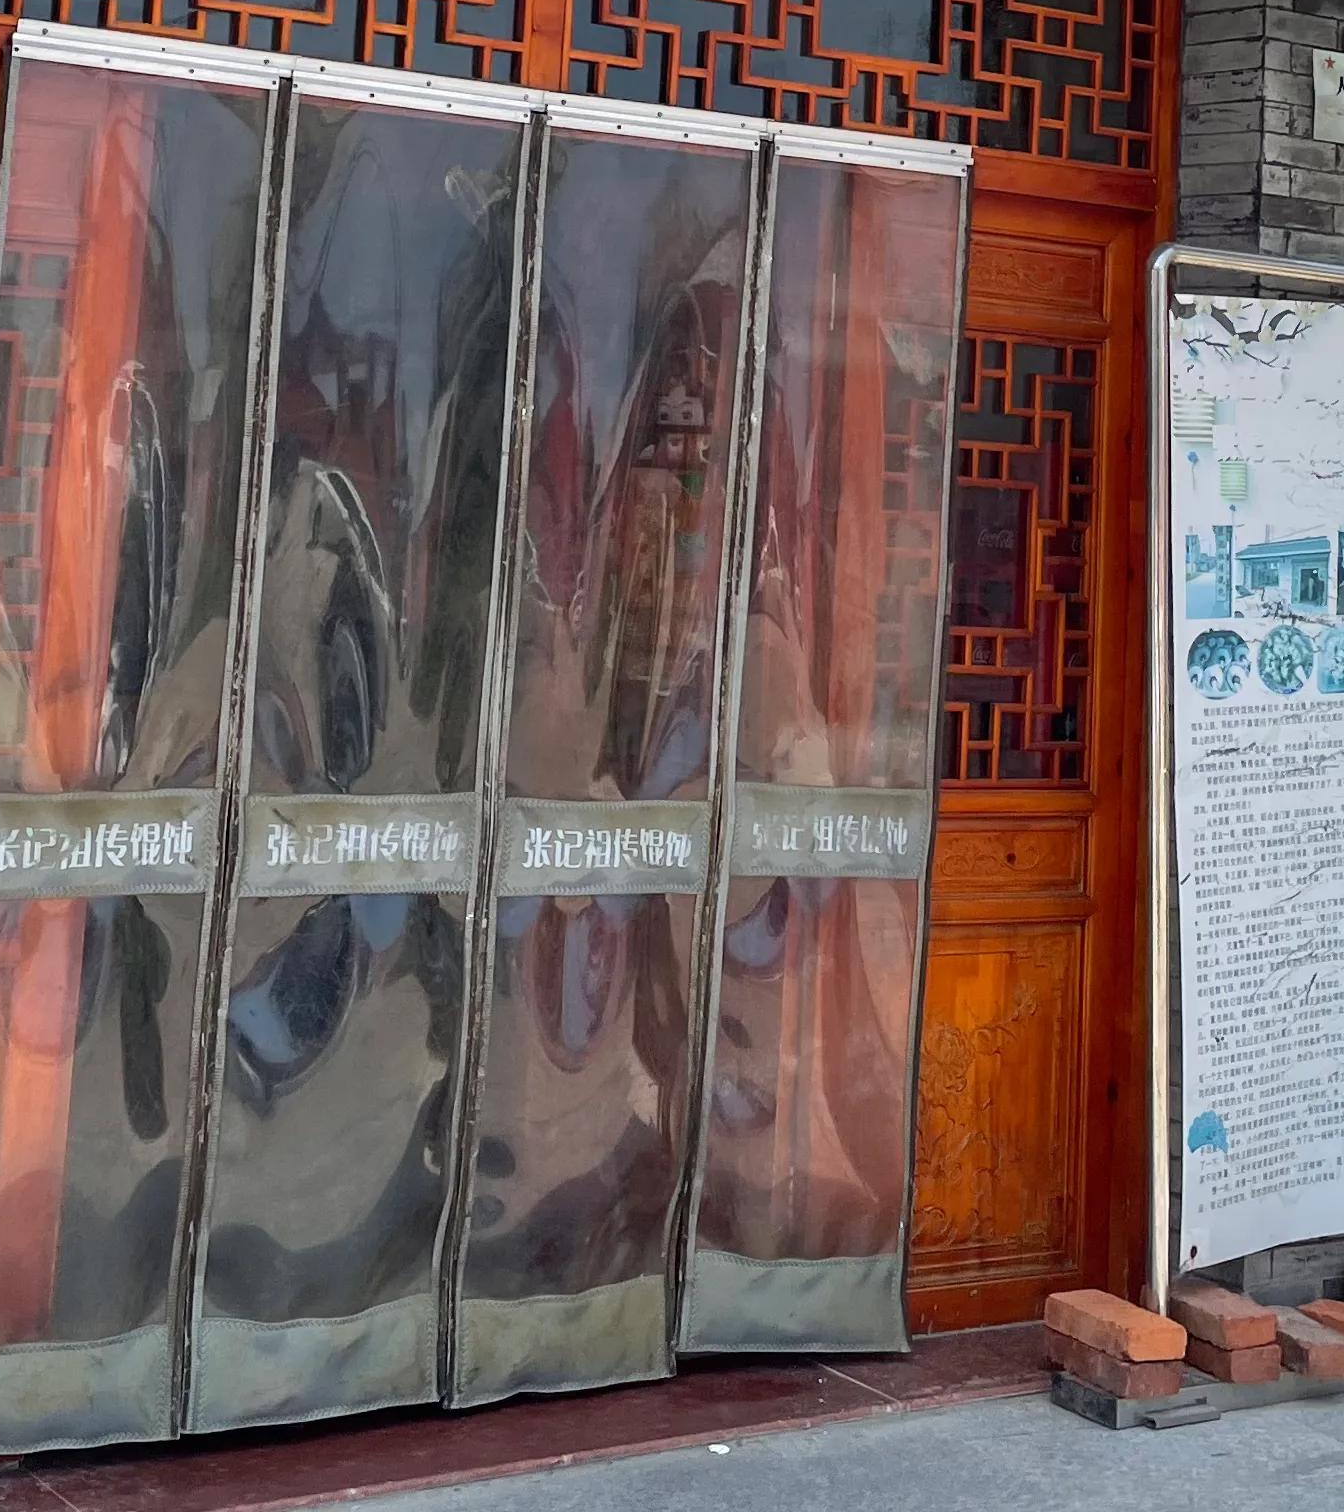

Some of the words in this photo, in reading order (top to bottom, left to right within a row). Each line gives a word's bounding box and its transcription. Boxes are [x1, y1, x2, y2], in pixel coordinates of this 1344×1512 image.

[522, 827, 693, 870] 张记祖传馄饨
